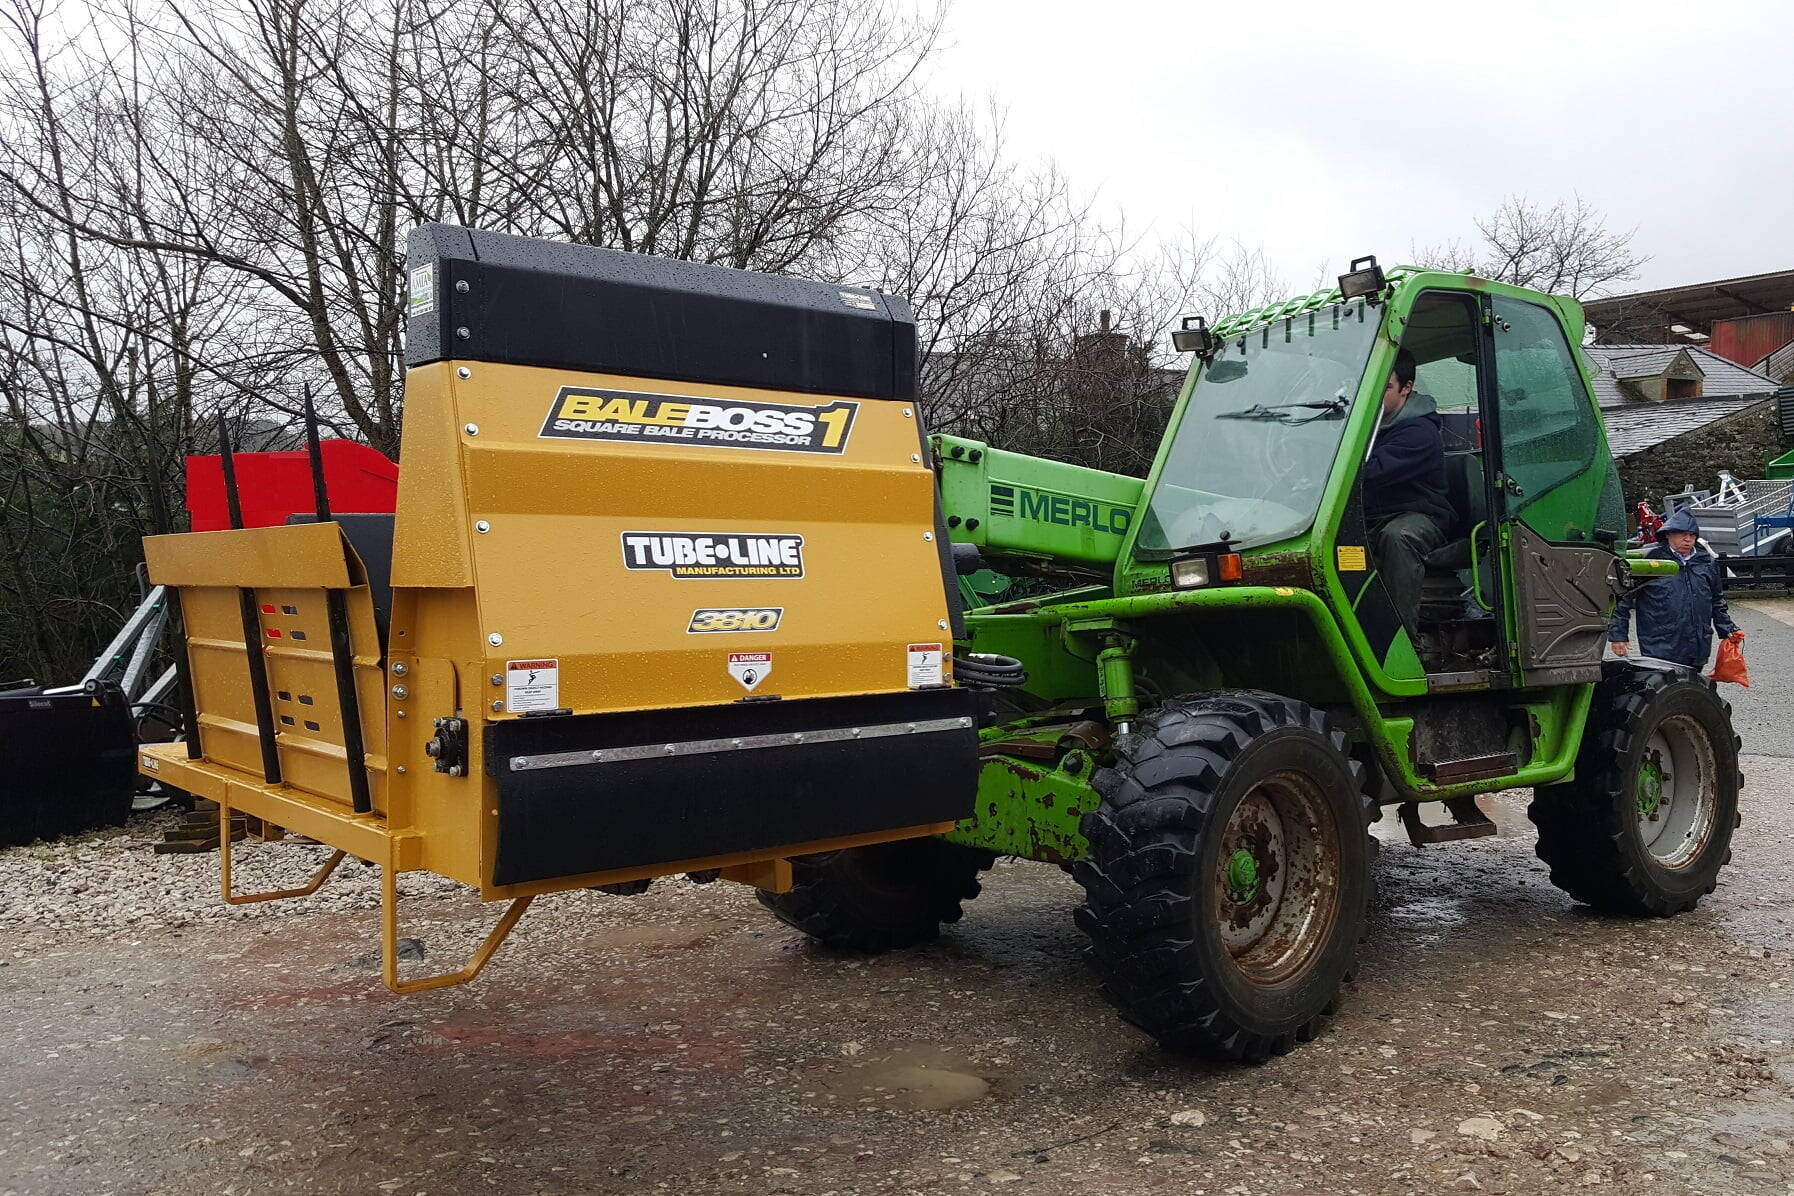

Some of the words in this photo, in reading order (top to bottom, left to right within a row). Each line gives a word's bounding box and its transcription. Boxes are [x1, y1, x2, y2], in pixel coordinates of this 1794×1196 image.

[554, 419, 642, 435] SQUARE
[644, 426, 696, 438] BALE
[697, 430, 811, 446] PROCESSOR
[1020, 490, 1131, 536] MERLO
[677, 567, 777, 575] MANUFACTURING
[779, 567, 800, 575] LTD
[691, 609, 778, 631] 3810
